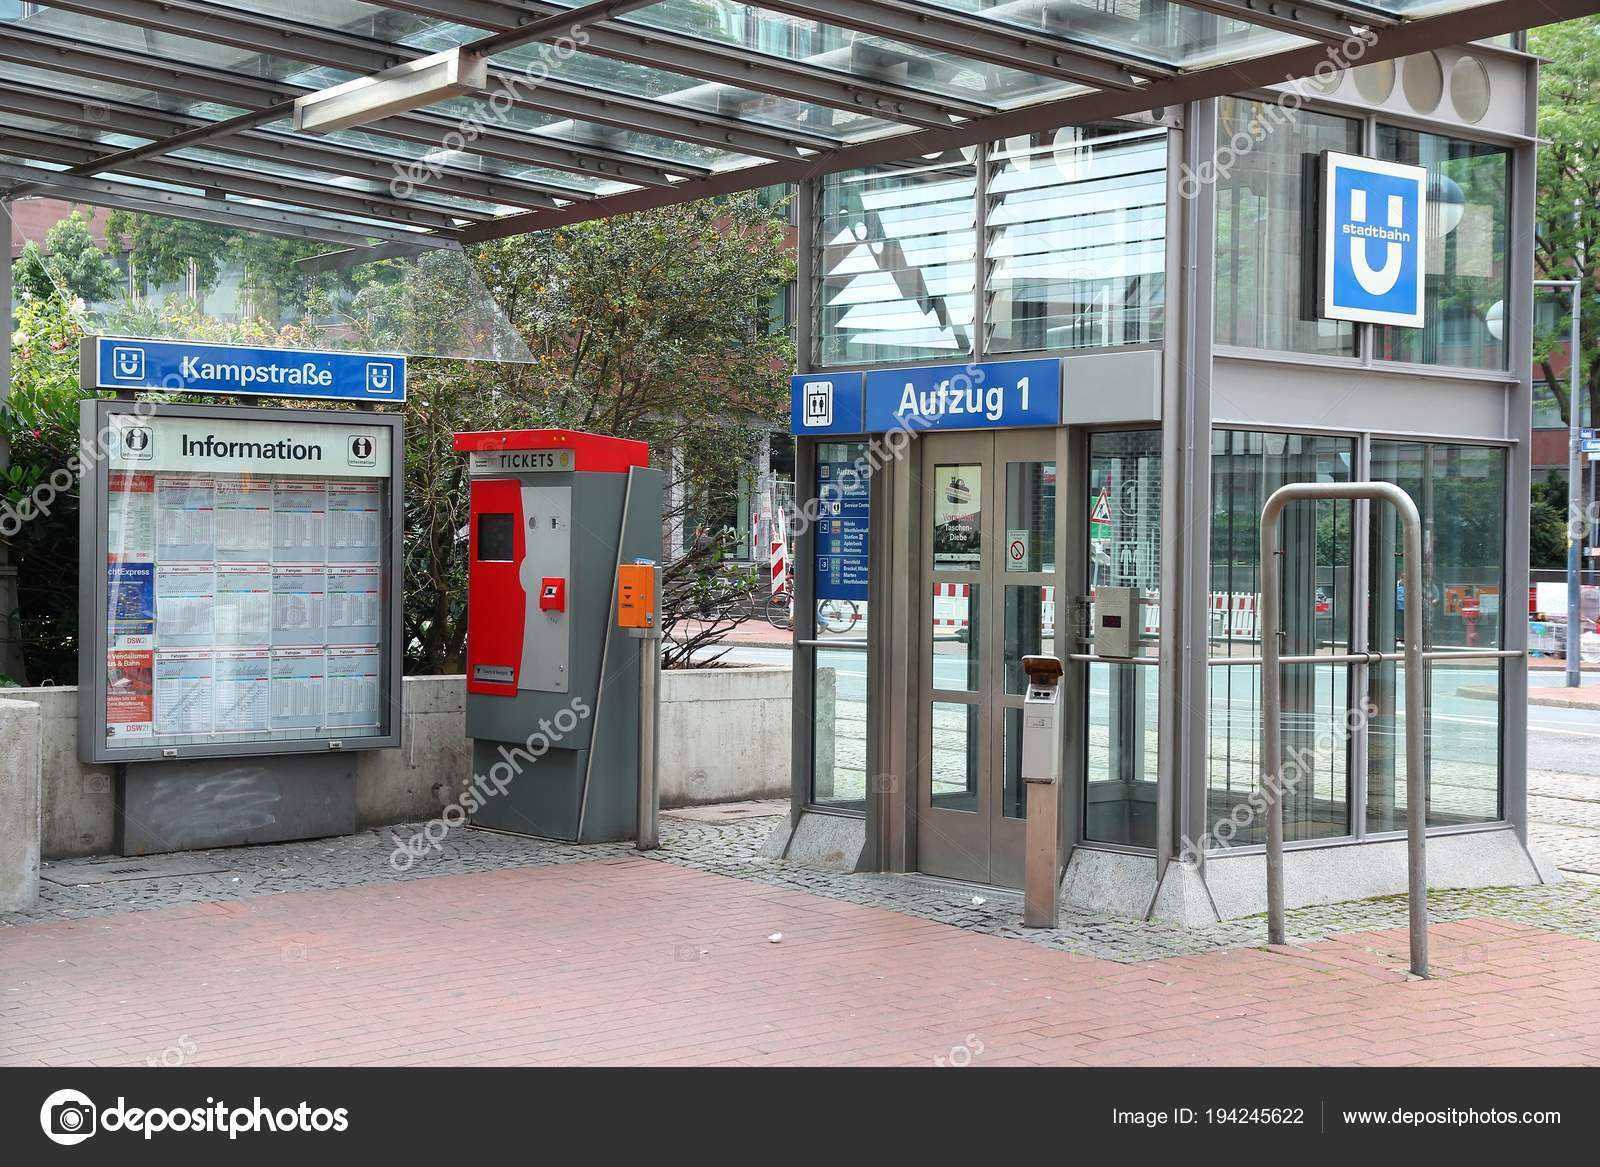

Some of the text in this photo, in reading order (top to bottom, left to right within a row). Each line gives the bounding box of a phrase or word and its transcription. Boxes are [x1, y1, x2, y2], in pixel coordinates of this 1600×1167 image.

[1342, 223, 1410, 242] stadtbahn
[182, 355, 333, 387] Kampstraße
[897, 376, 1030, 421] Aufzug 1
[182, 434, 322, 461] Information
[499, 453, 554, 468] TICKETS
[944, 523, 973, 532] Taschen-
[949, 533, 967, 541] Diebe
